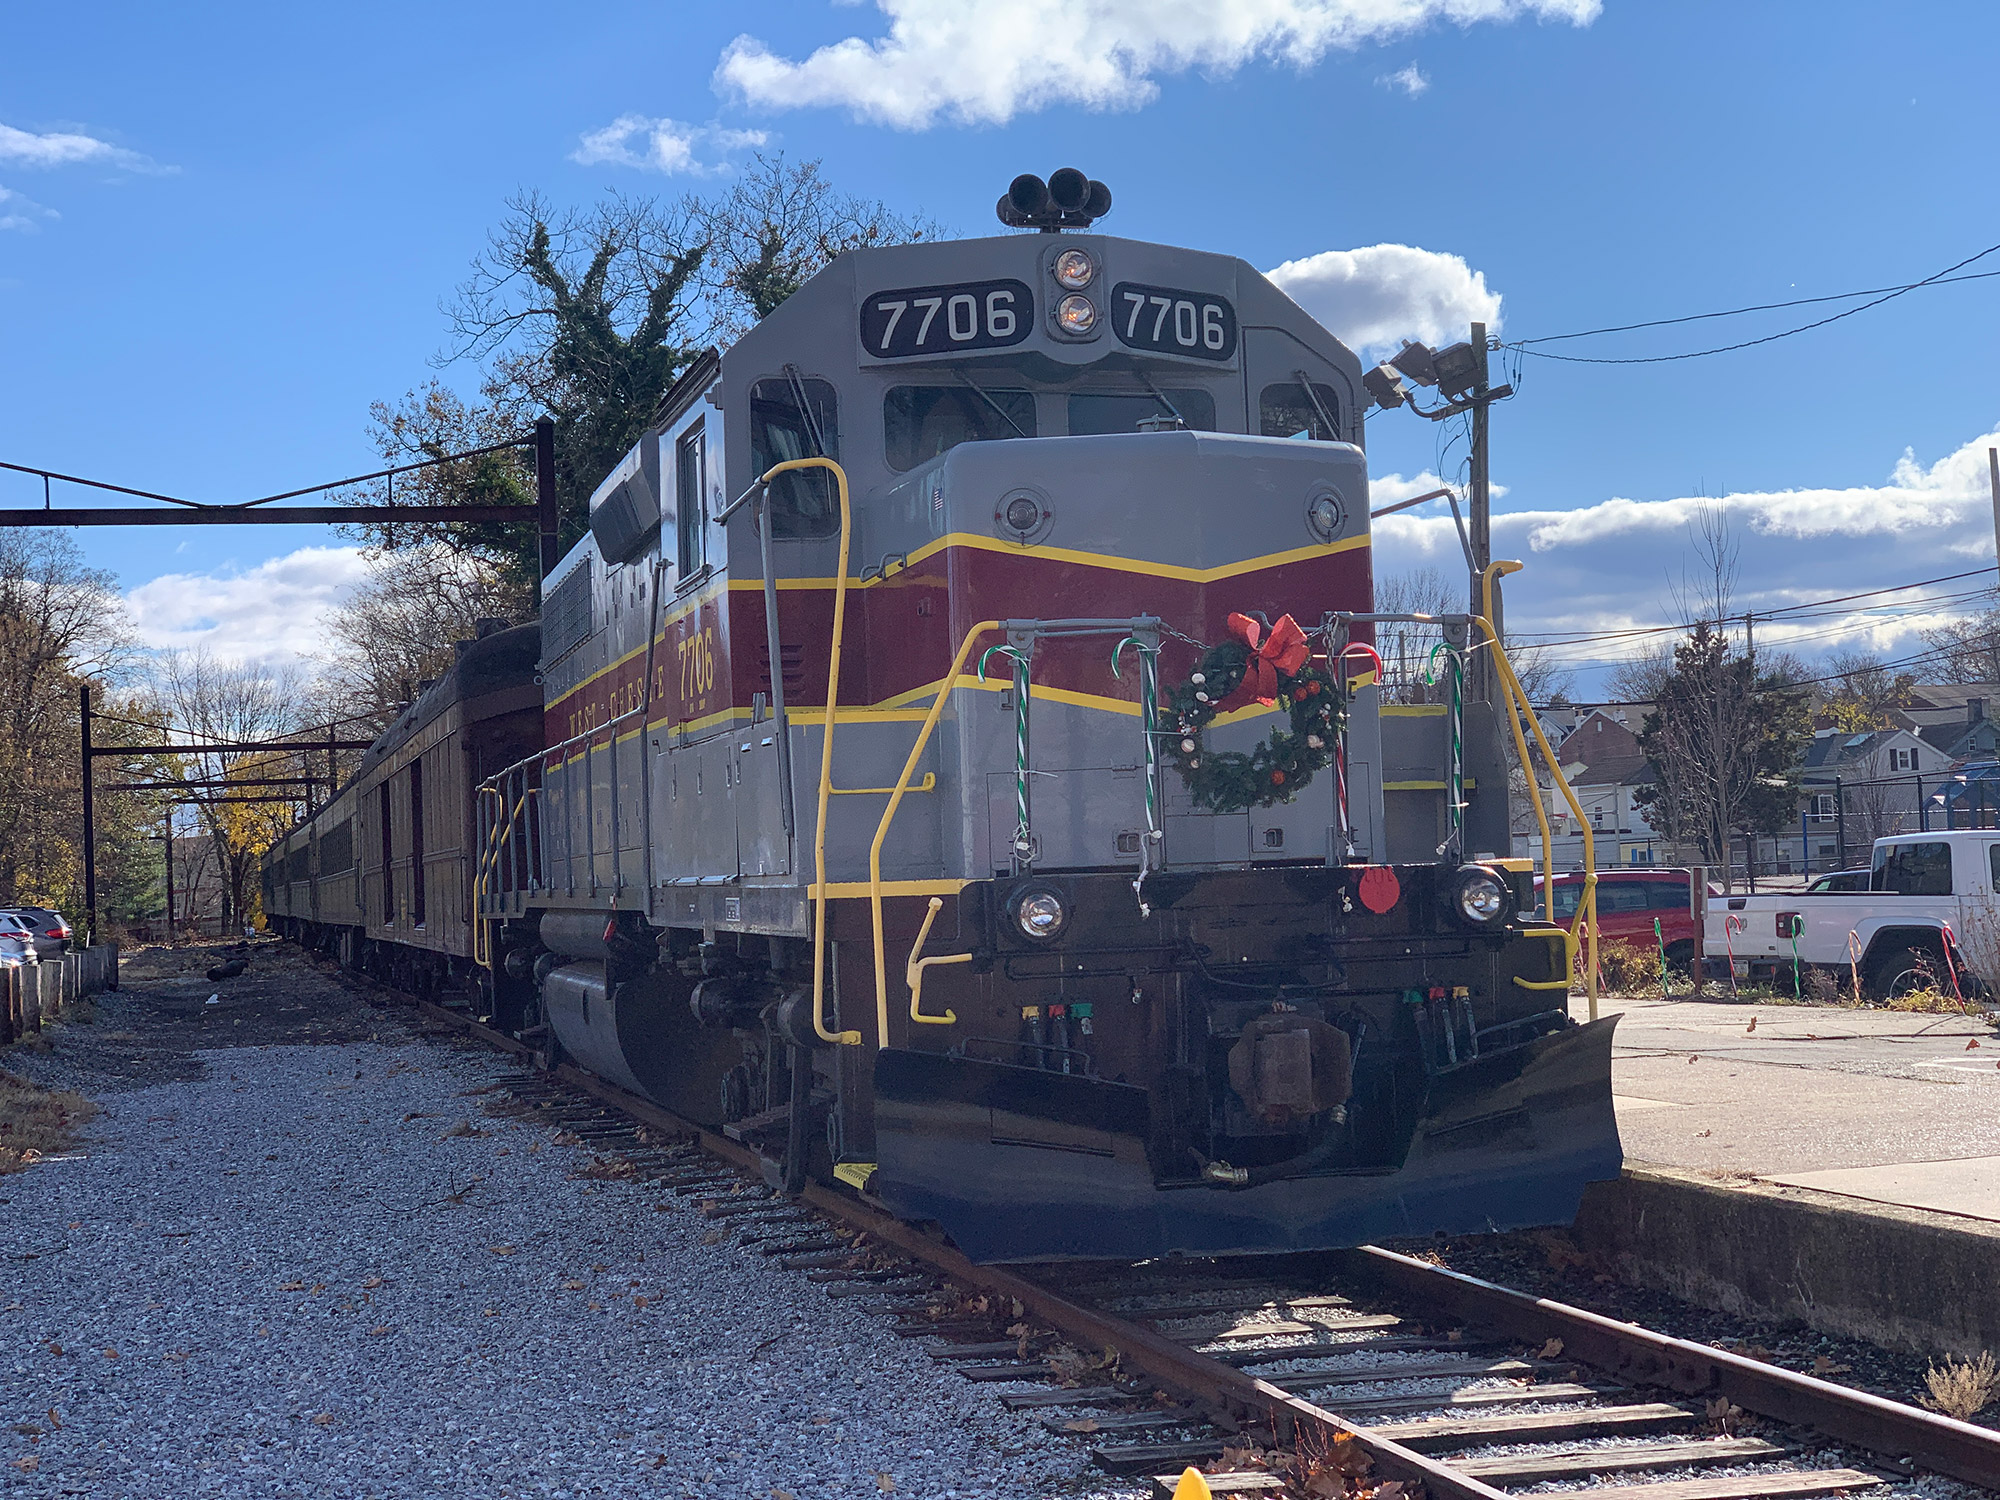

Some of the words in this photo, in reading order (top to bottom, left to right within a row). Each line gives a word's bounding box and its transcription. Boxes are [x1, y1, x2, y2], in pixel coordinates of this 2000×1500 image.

[878, 290, 1016, 350] 7706
[1123, 291, 1225, 350] 7706
[678, 627, 713, 701] 7706
